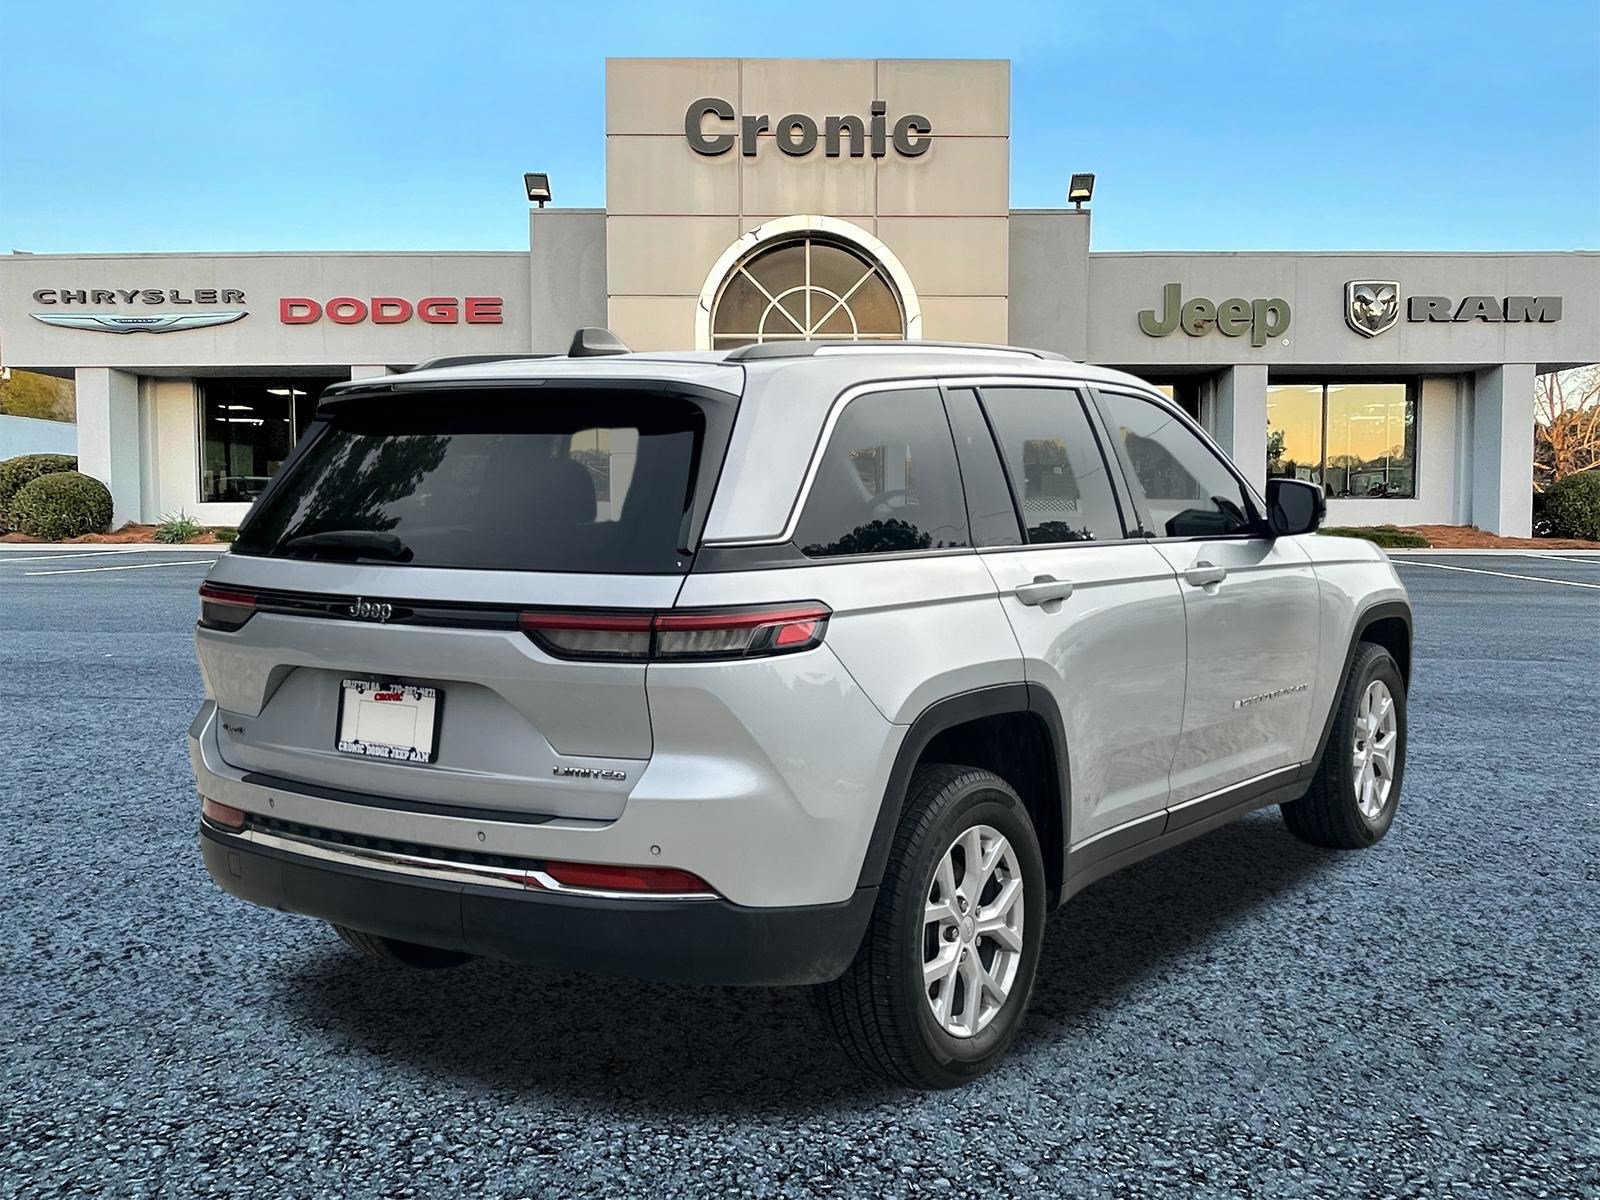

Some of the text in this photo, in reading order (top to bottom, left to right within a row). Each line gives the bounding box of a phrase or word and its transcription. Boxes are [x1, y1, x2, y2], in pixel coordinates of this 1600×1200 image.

[684, 97, 932, 158] Cronic
[32, 288, 246, 305] CHRYSLER
[1407, 296, 1563, 323] RAM
[279, 296, 504, 325] DODGE
[1138, 282, 1292, 347] Jeep
[348, 596, 392, 623] Jeep
[338, 741, 430, 763] CRONIC DODGE JEEP RAM
[552, 765, 627, 781] LIMITED
